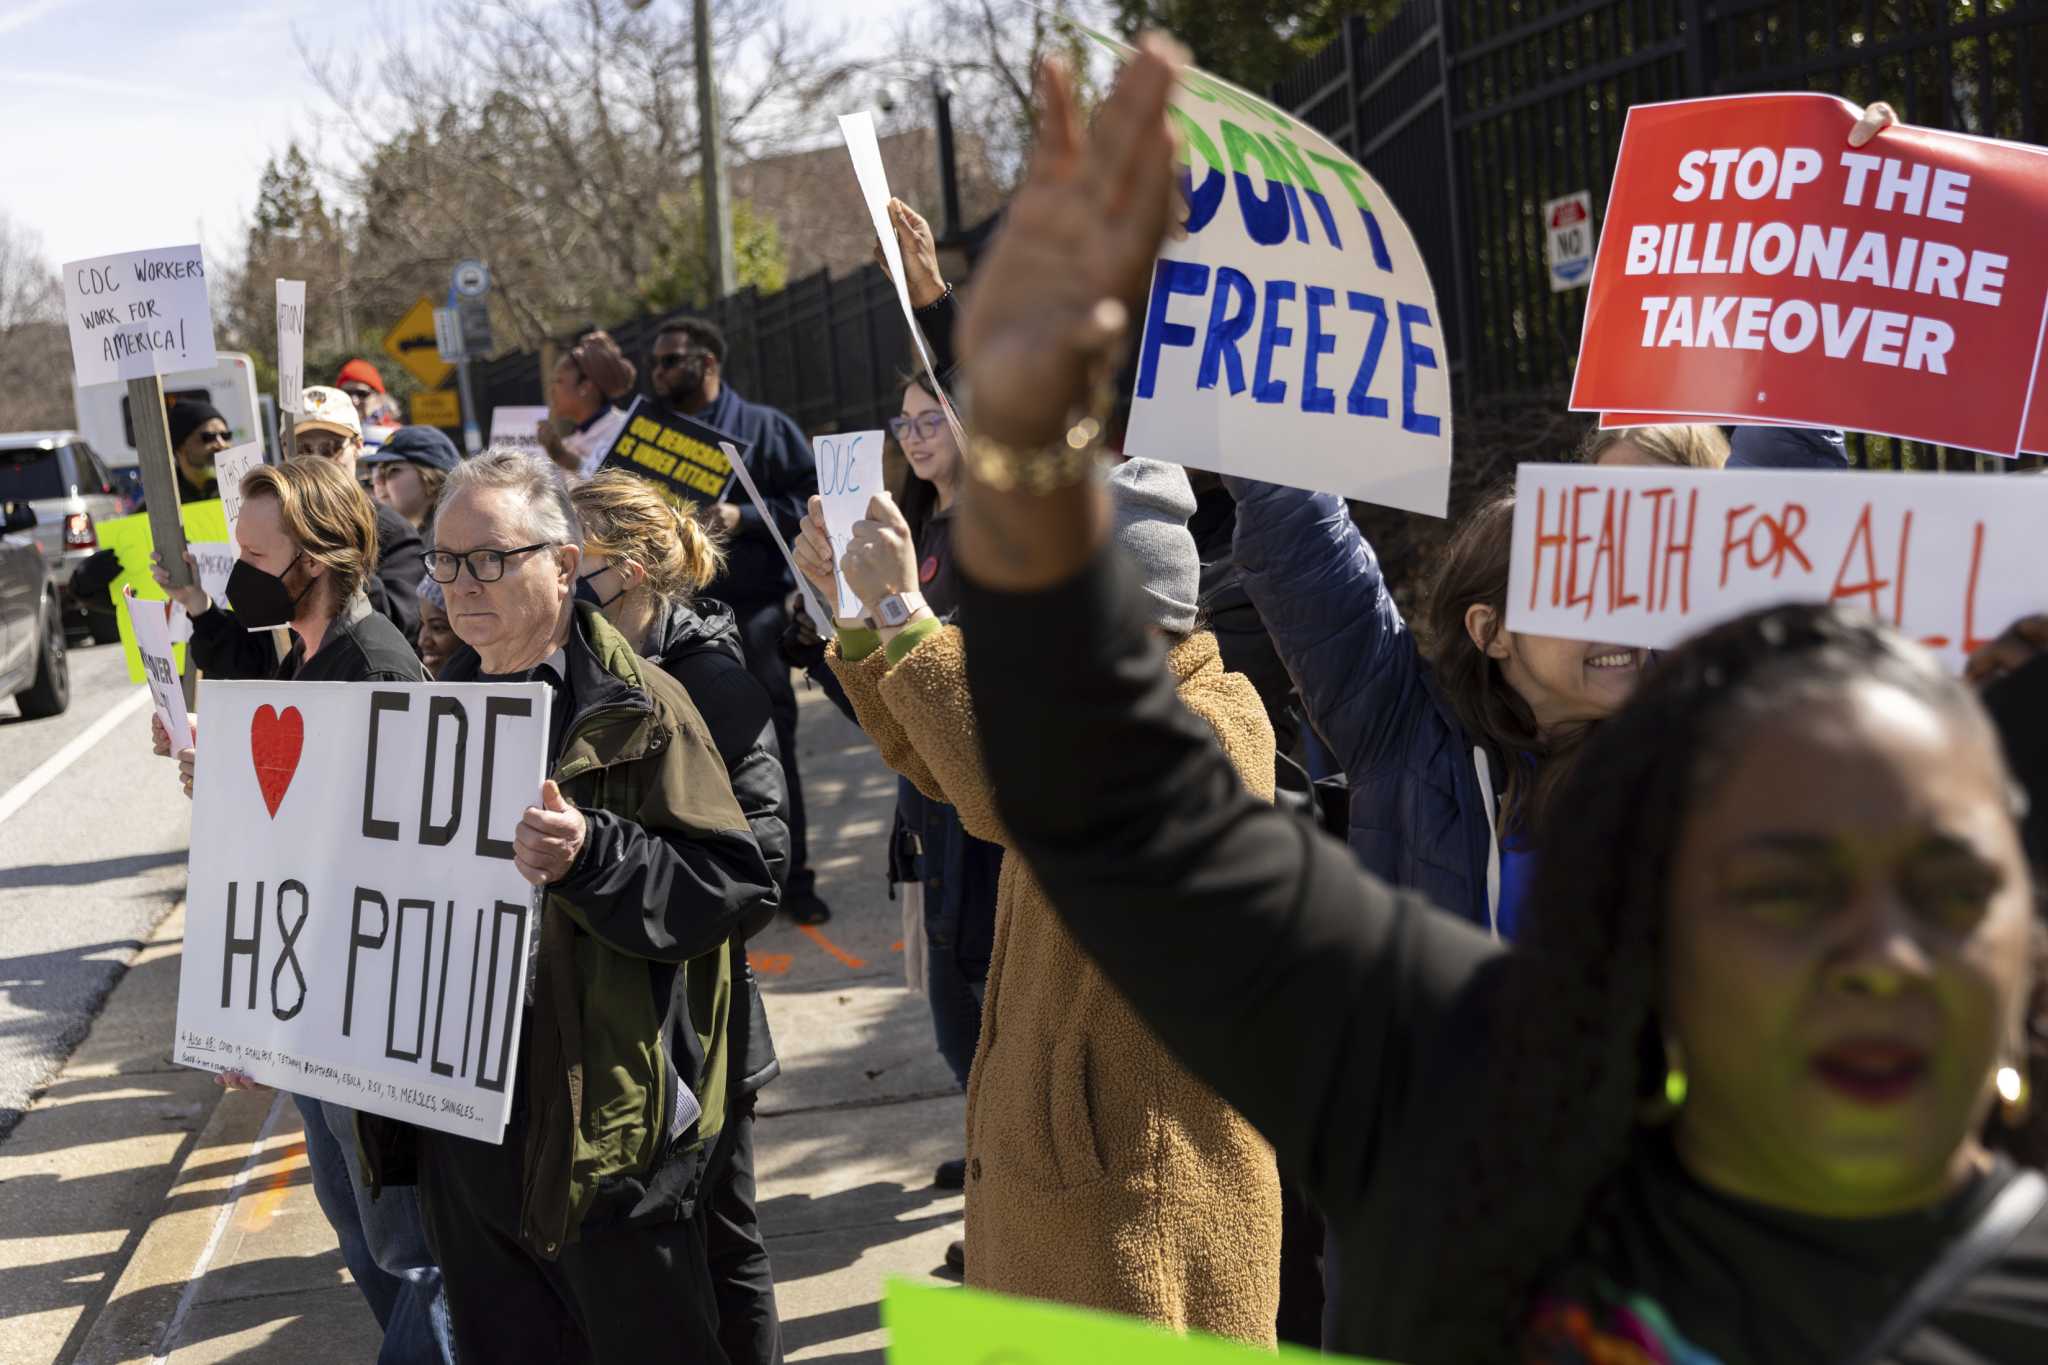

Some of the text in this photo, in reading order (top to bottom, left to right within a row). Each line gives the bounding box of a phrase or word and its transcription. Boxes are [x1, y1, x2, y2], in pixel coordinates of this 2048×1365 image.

[1671, 146, 1972, 225] STOP THE
[78, 258, 205, 295] CDC WORKERS
[1557, 229, 1582, 259] NO
[1624, 221, 2009, 308] BILLIONAIRE
[81, 299, 162, 330] WORK FOR
[103, 317, 187, 361] AMERICA!
[1136, 258, 1441, 437] FREEZE
[1640, 296, 1956, 376] TAKEOVER
[821, 436, 863, 496] DUE
[1530, 486, 2002, 656] HEALTH FOR ALL
[362, 691, 532, 859] CDC
[221, 878, 527, 1093] H8 POLIO
